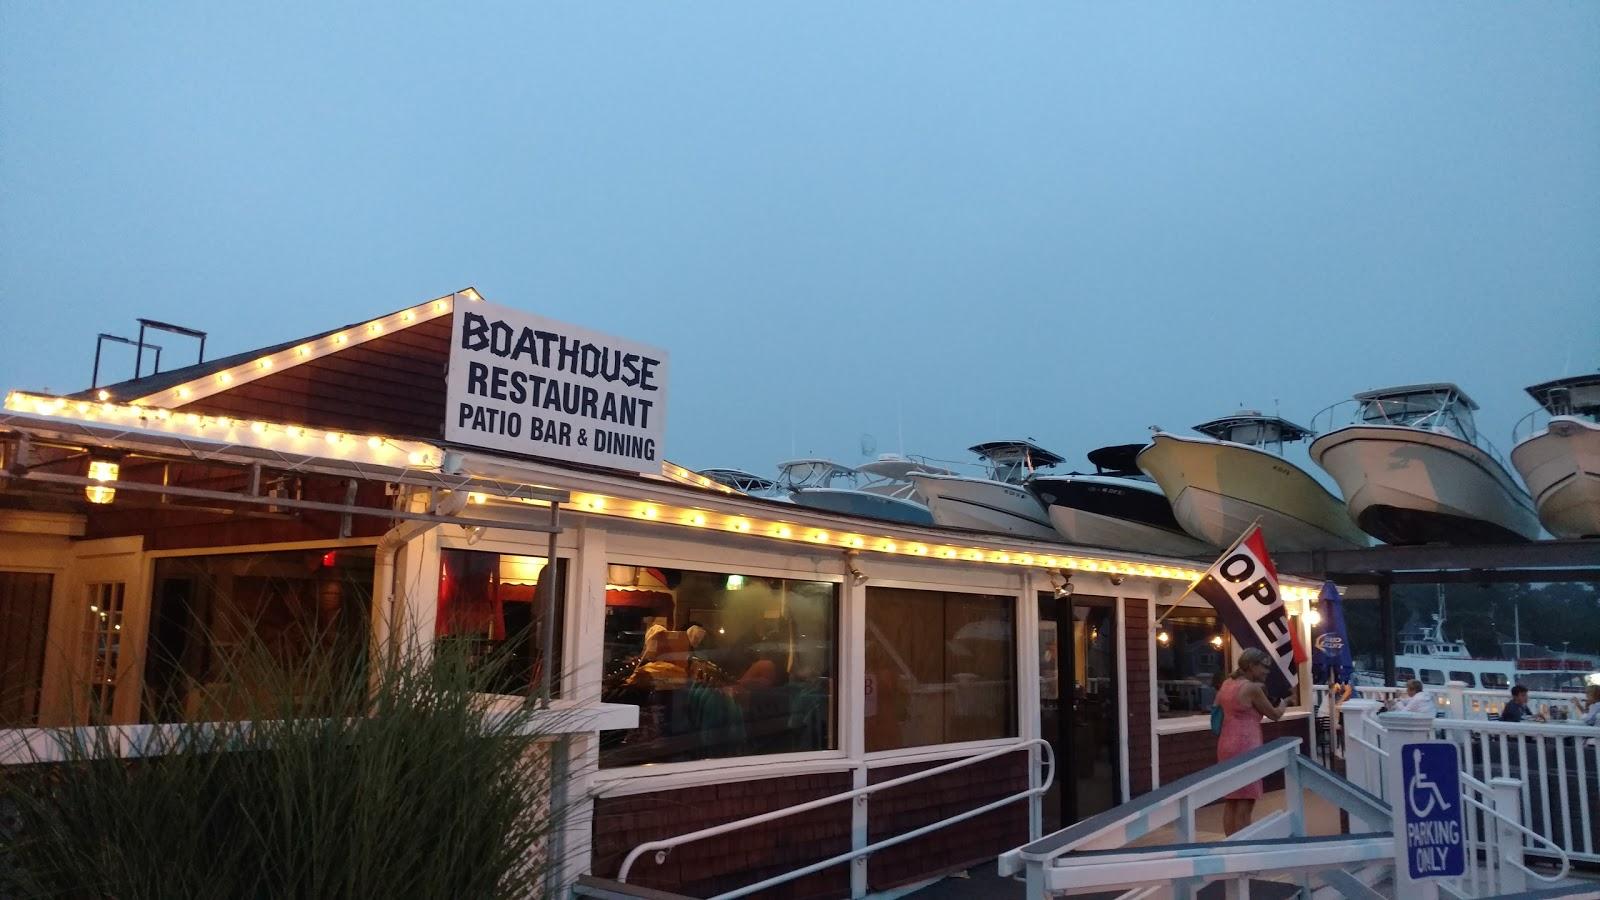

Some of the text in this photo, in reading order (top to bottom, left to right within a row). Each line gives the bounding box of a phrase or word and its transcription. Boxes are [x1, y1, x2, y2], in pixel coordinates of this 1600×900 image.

[462, 312, 660, 391] BOATHOUSE
[467, 361, 653, 429] RESTAURANT
[459, 402, 655, 461] PATIO BAR & DINING
[1408, 821, 1460, 848] PARKING
[1416, 846, 1449, 873] ONLY
